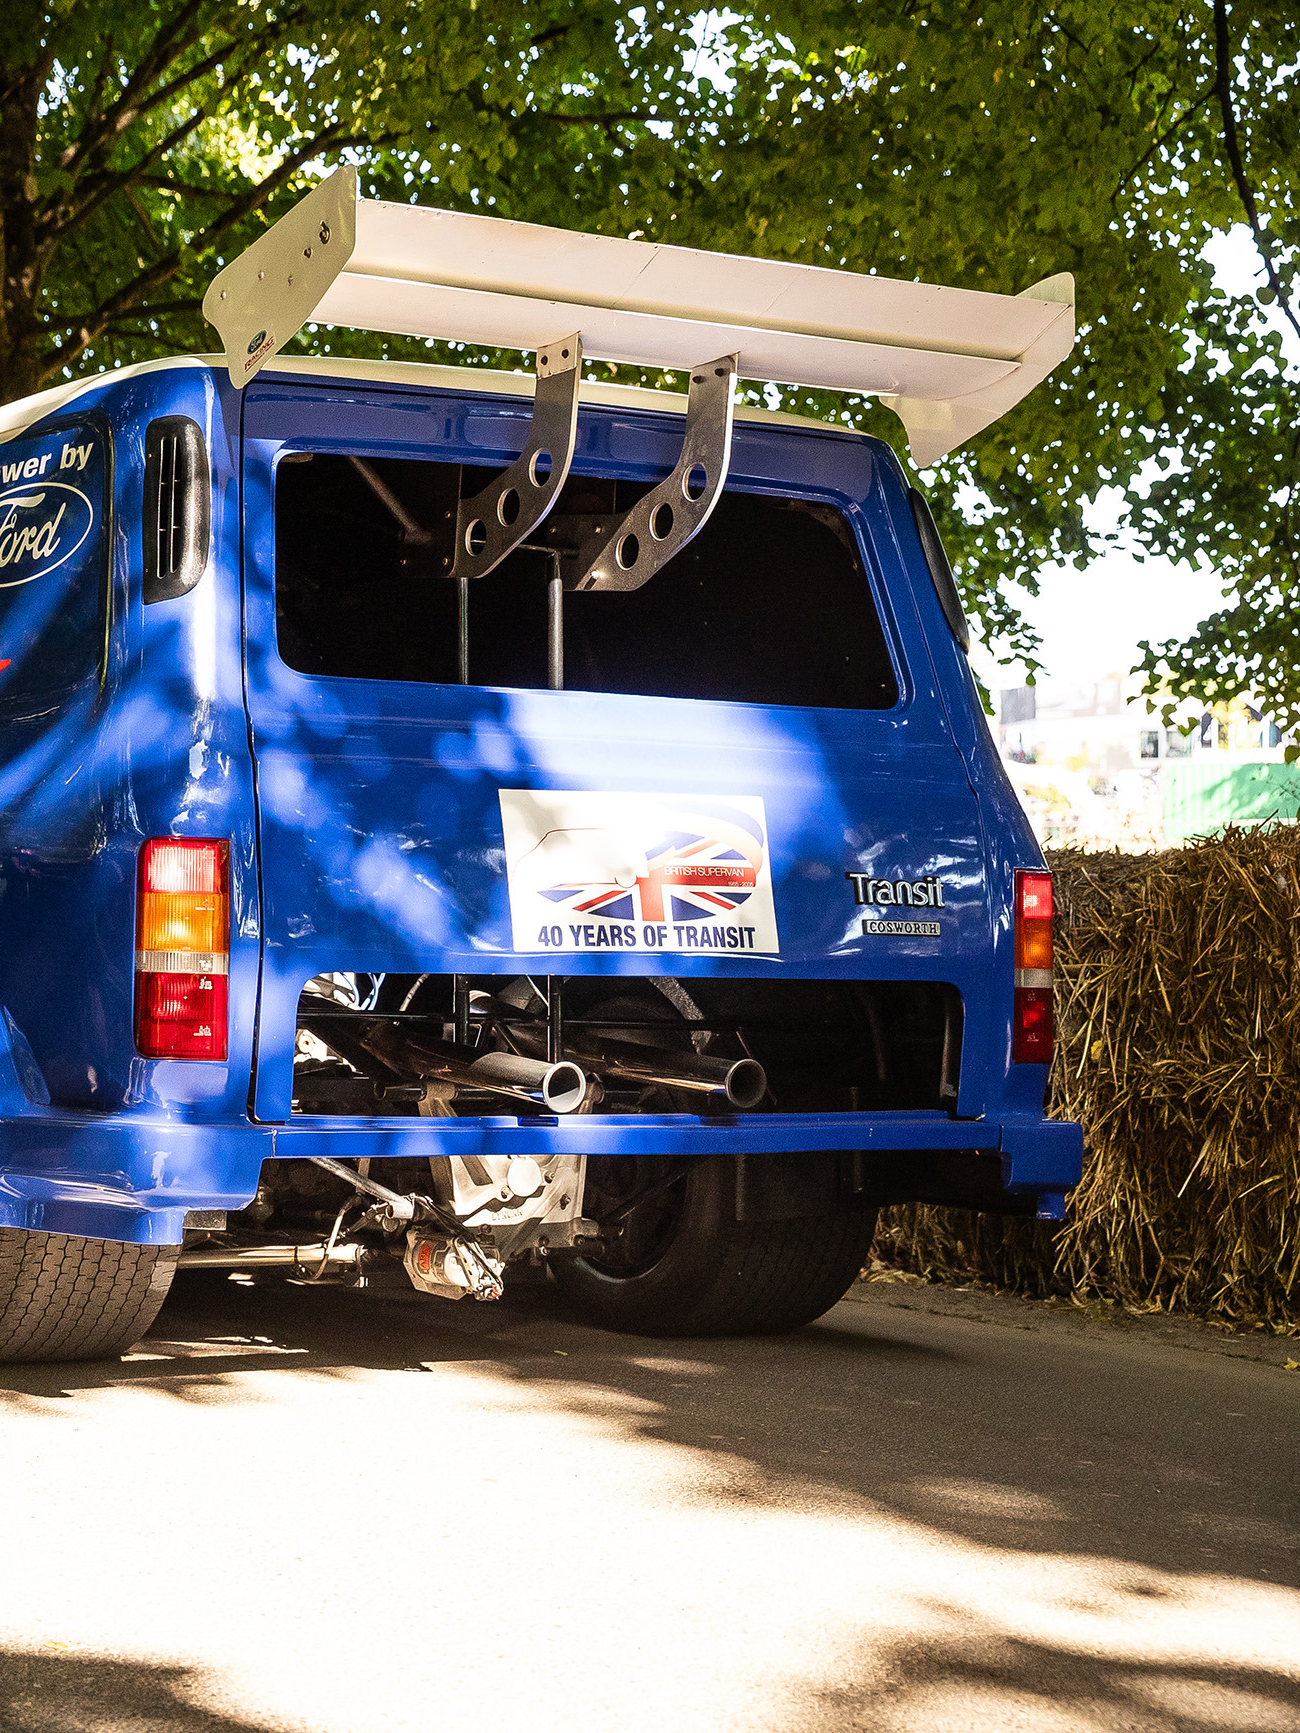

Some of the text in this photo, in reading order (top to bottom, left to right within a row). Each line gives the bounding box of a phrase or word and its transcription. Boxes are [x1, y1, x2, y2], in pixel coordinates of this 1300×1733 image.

[59, 442, 94, 470] by
[664, 866, 744, 877] BRITISH SUPERVAN
[846, 872, 945, 908] Transit
[538, 925, 756, 949] 40 YEARS OF TRANSIT
[869, 921, 938, 934] COSWORTH
